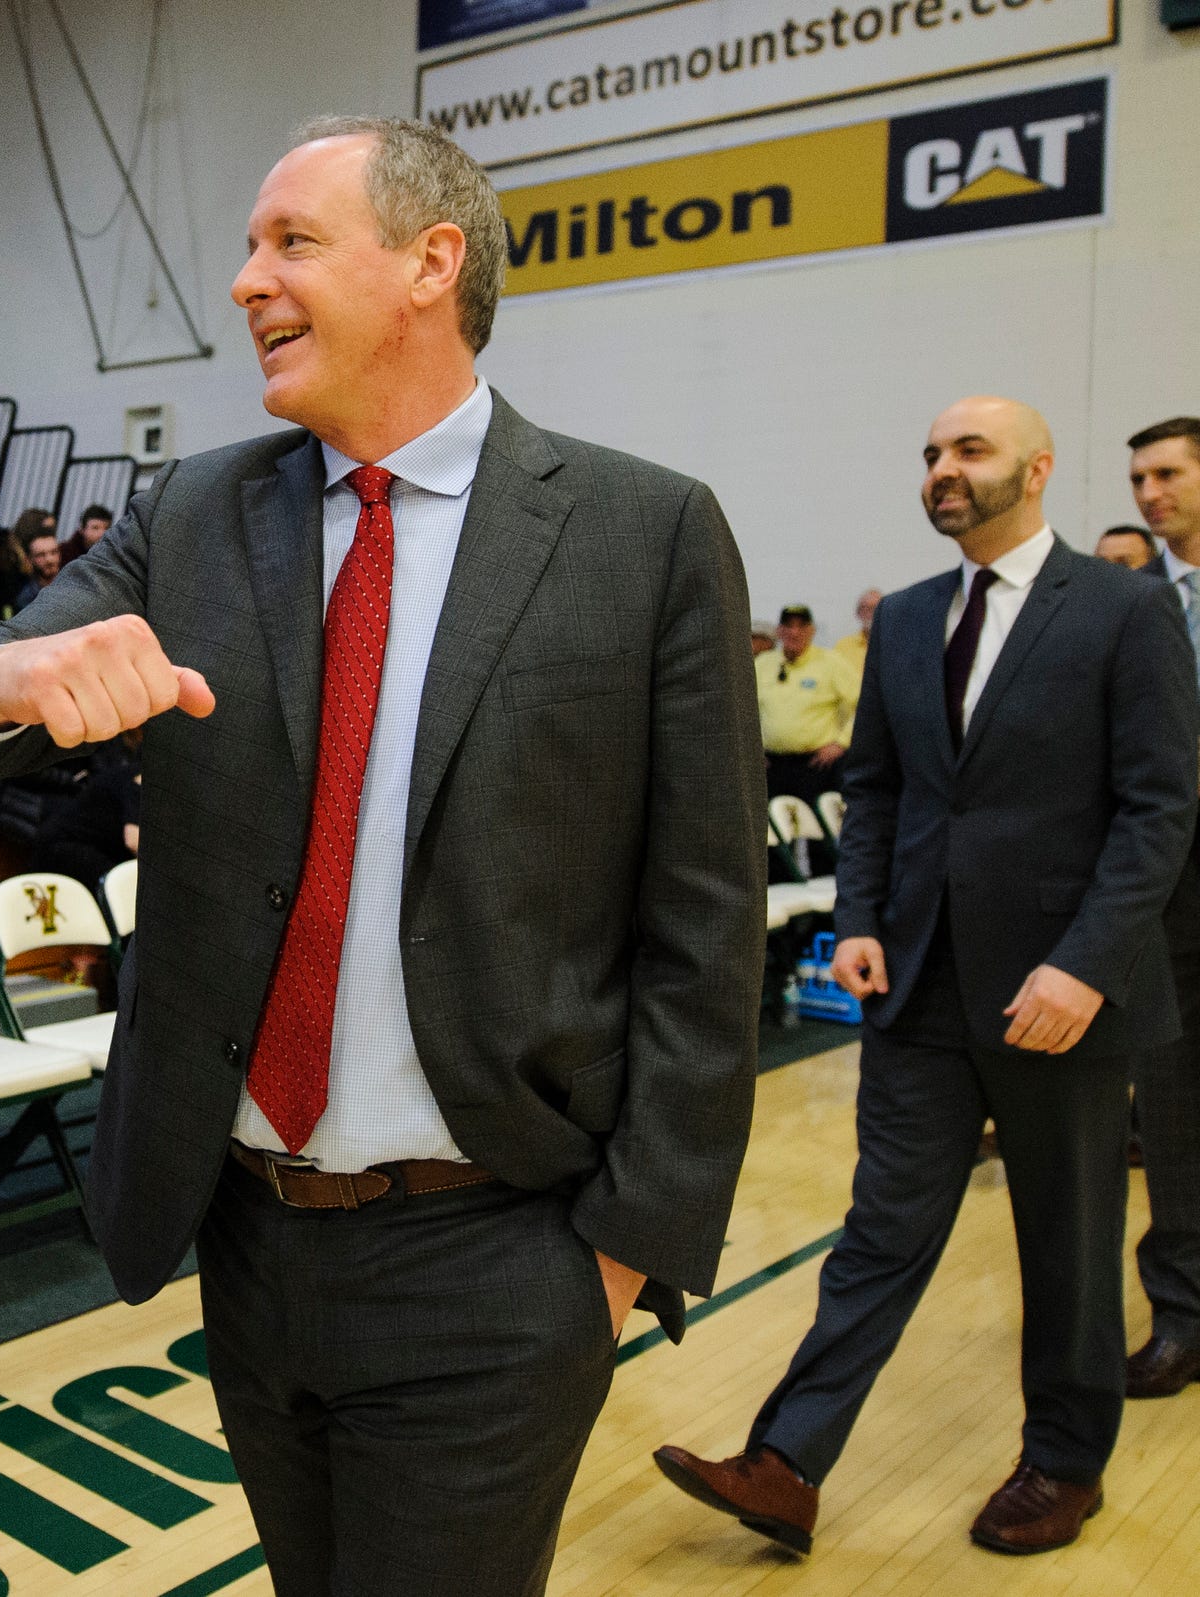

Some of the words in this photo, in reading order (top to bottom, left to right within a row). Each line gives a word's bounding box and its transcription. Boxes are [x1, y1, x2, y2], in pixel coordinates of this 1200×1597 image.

[428, 0, 1051, 132] www.catamountstore.c
[496, 184, 791, 268] Milton
[904, 114, 1086, 210] CAT
